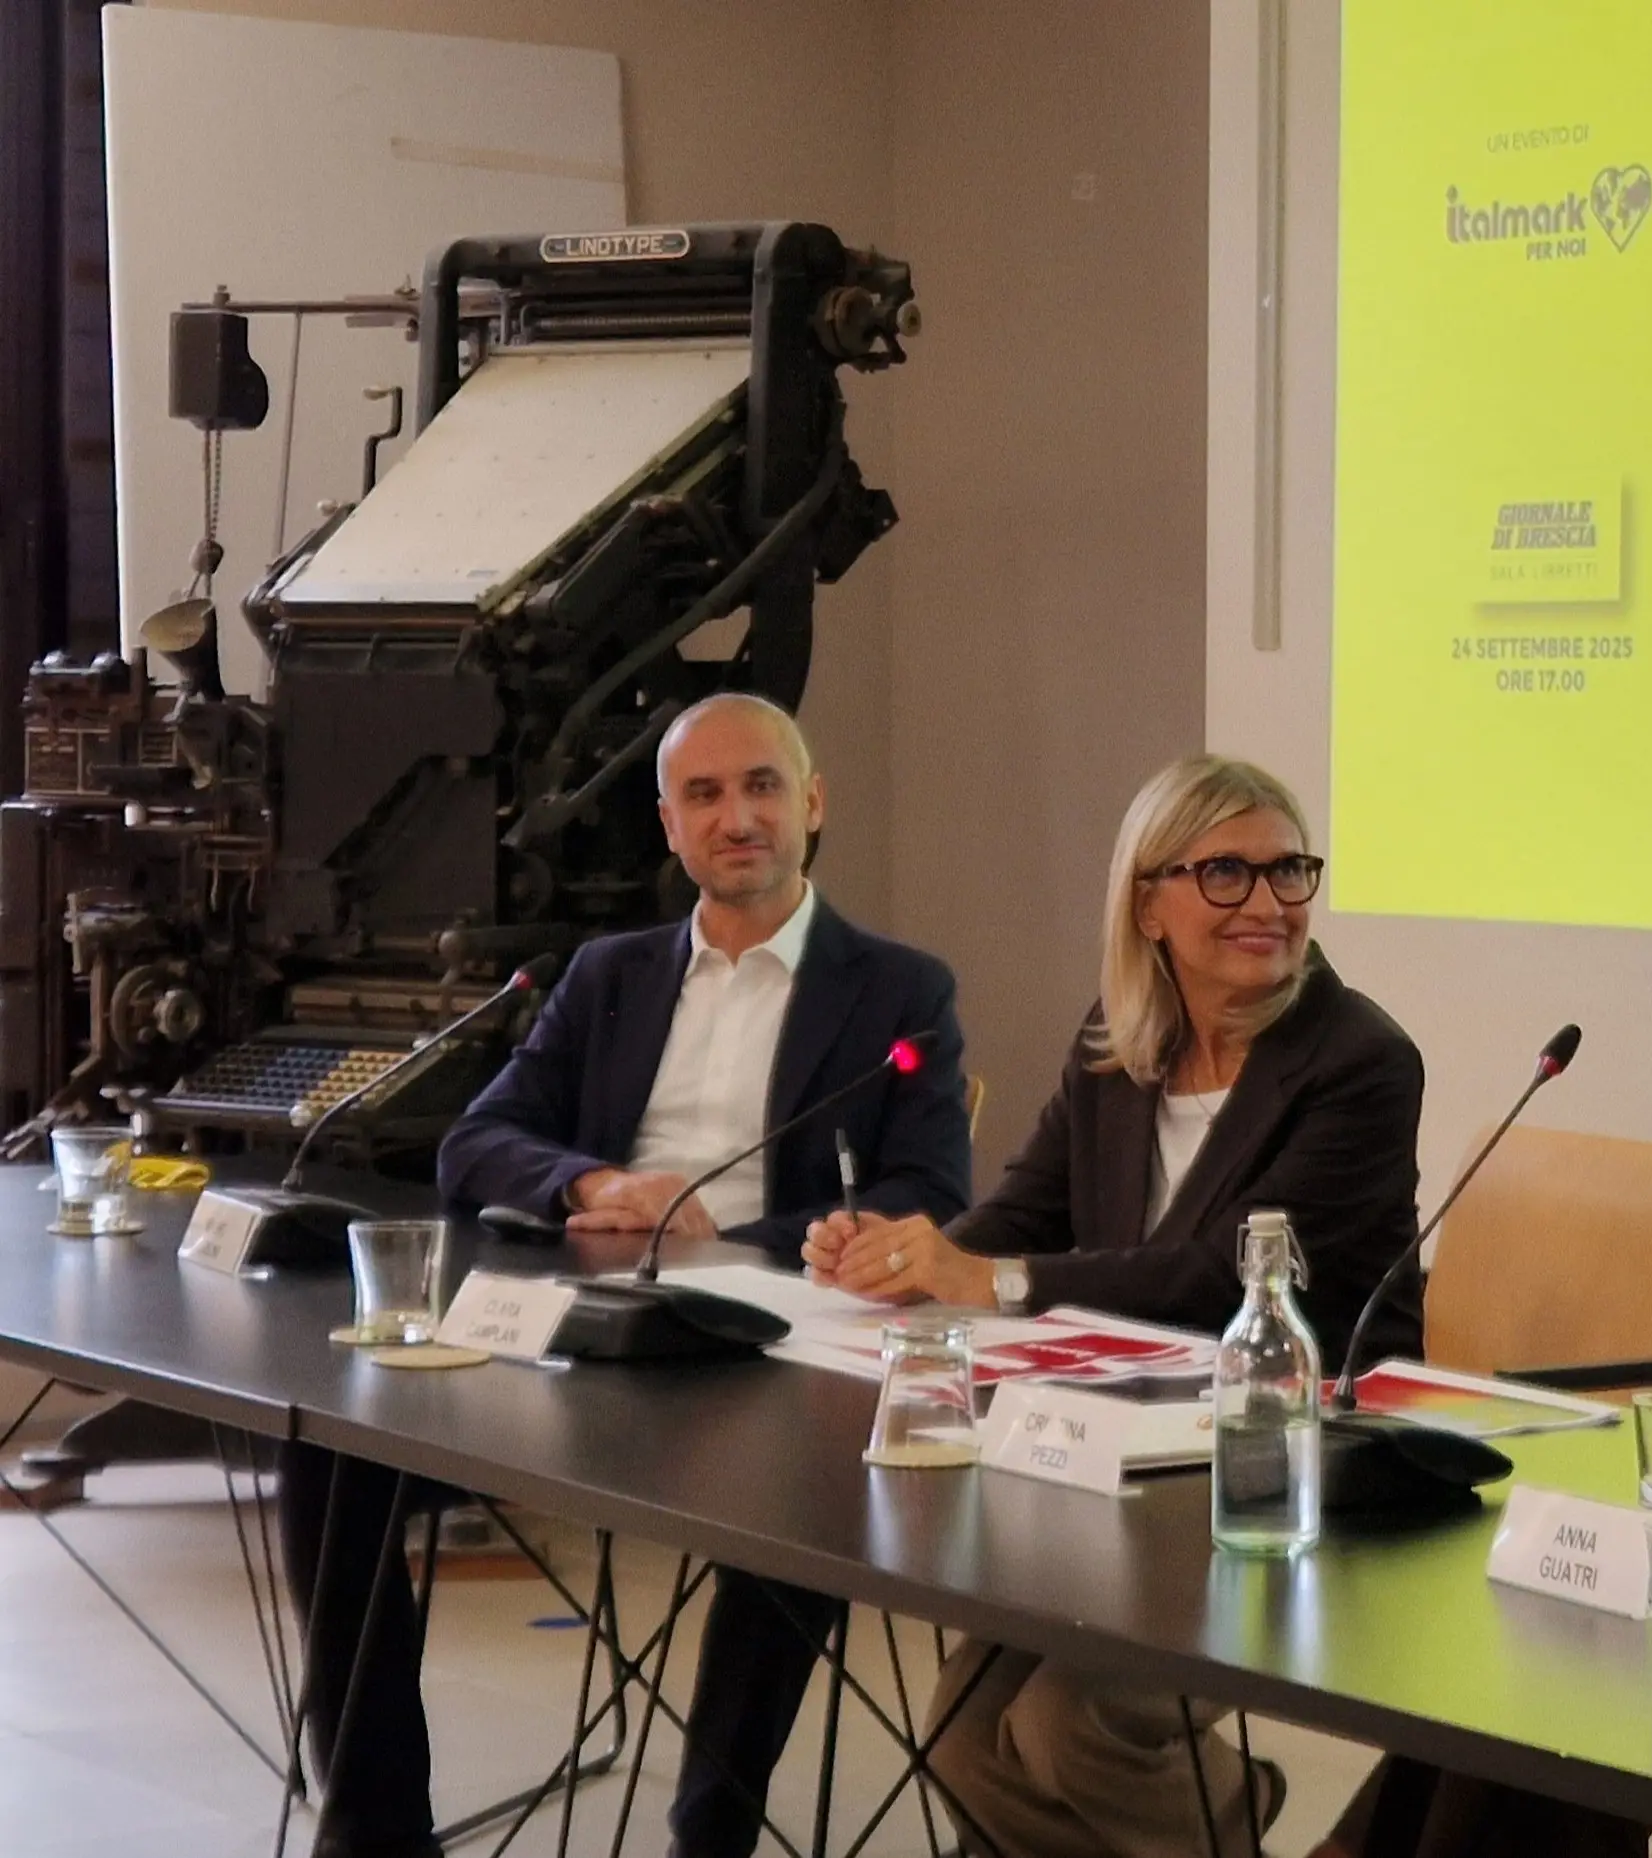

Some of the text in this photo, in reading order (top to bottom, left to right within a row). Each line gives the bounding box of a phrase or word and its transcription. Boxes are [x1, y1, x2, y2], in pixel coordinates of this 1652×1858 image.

[1487, 134, 1509, 153] UN
[1512, 126, 1570, 151] EVENTO
[1446, 184, 1589, 243] italmark
[565, 235, 664, 256] LINOTYPE
[1525, 238, 1587, 261] PER NOI
[1497, 501, 1593, 526] GIORNALE
[1491, 525, 1596, 550] DI BRESCIA
[1451, 636, 1634, 659] 24 SETTEMBRE 2025
[1496, 669, 1585, 691] ORE 17.00
[1029, 1445, 1068, 1470] PEZZI
[1553, 1523, 1598, 1553] ANNA
[1539, 1556, 1599, 1591] GUATRI
